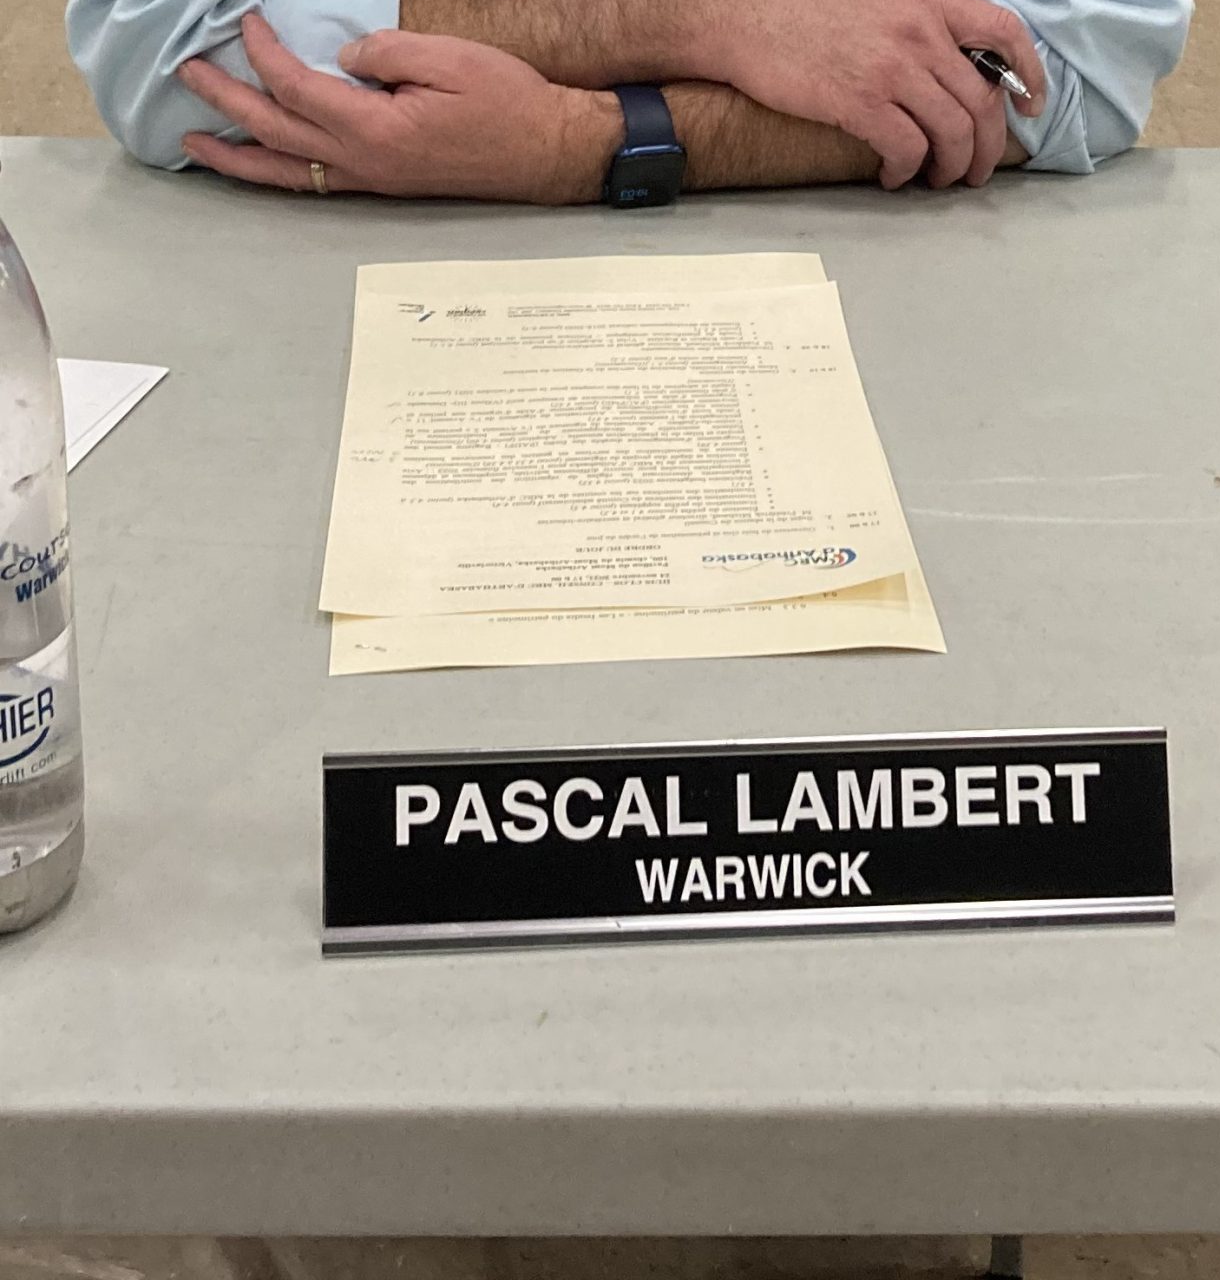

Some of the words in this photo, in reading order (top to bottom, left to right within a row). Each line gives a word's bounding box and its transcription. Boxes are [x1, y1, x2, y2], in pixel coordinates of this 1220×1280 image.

[784, 556, 827, 567] MRC
[394, 774, 709, 846] PASCAL
[735, 763, 1101, 836] LAMBERT
[635, 851, 872, 903] WARWICK
